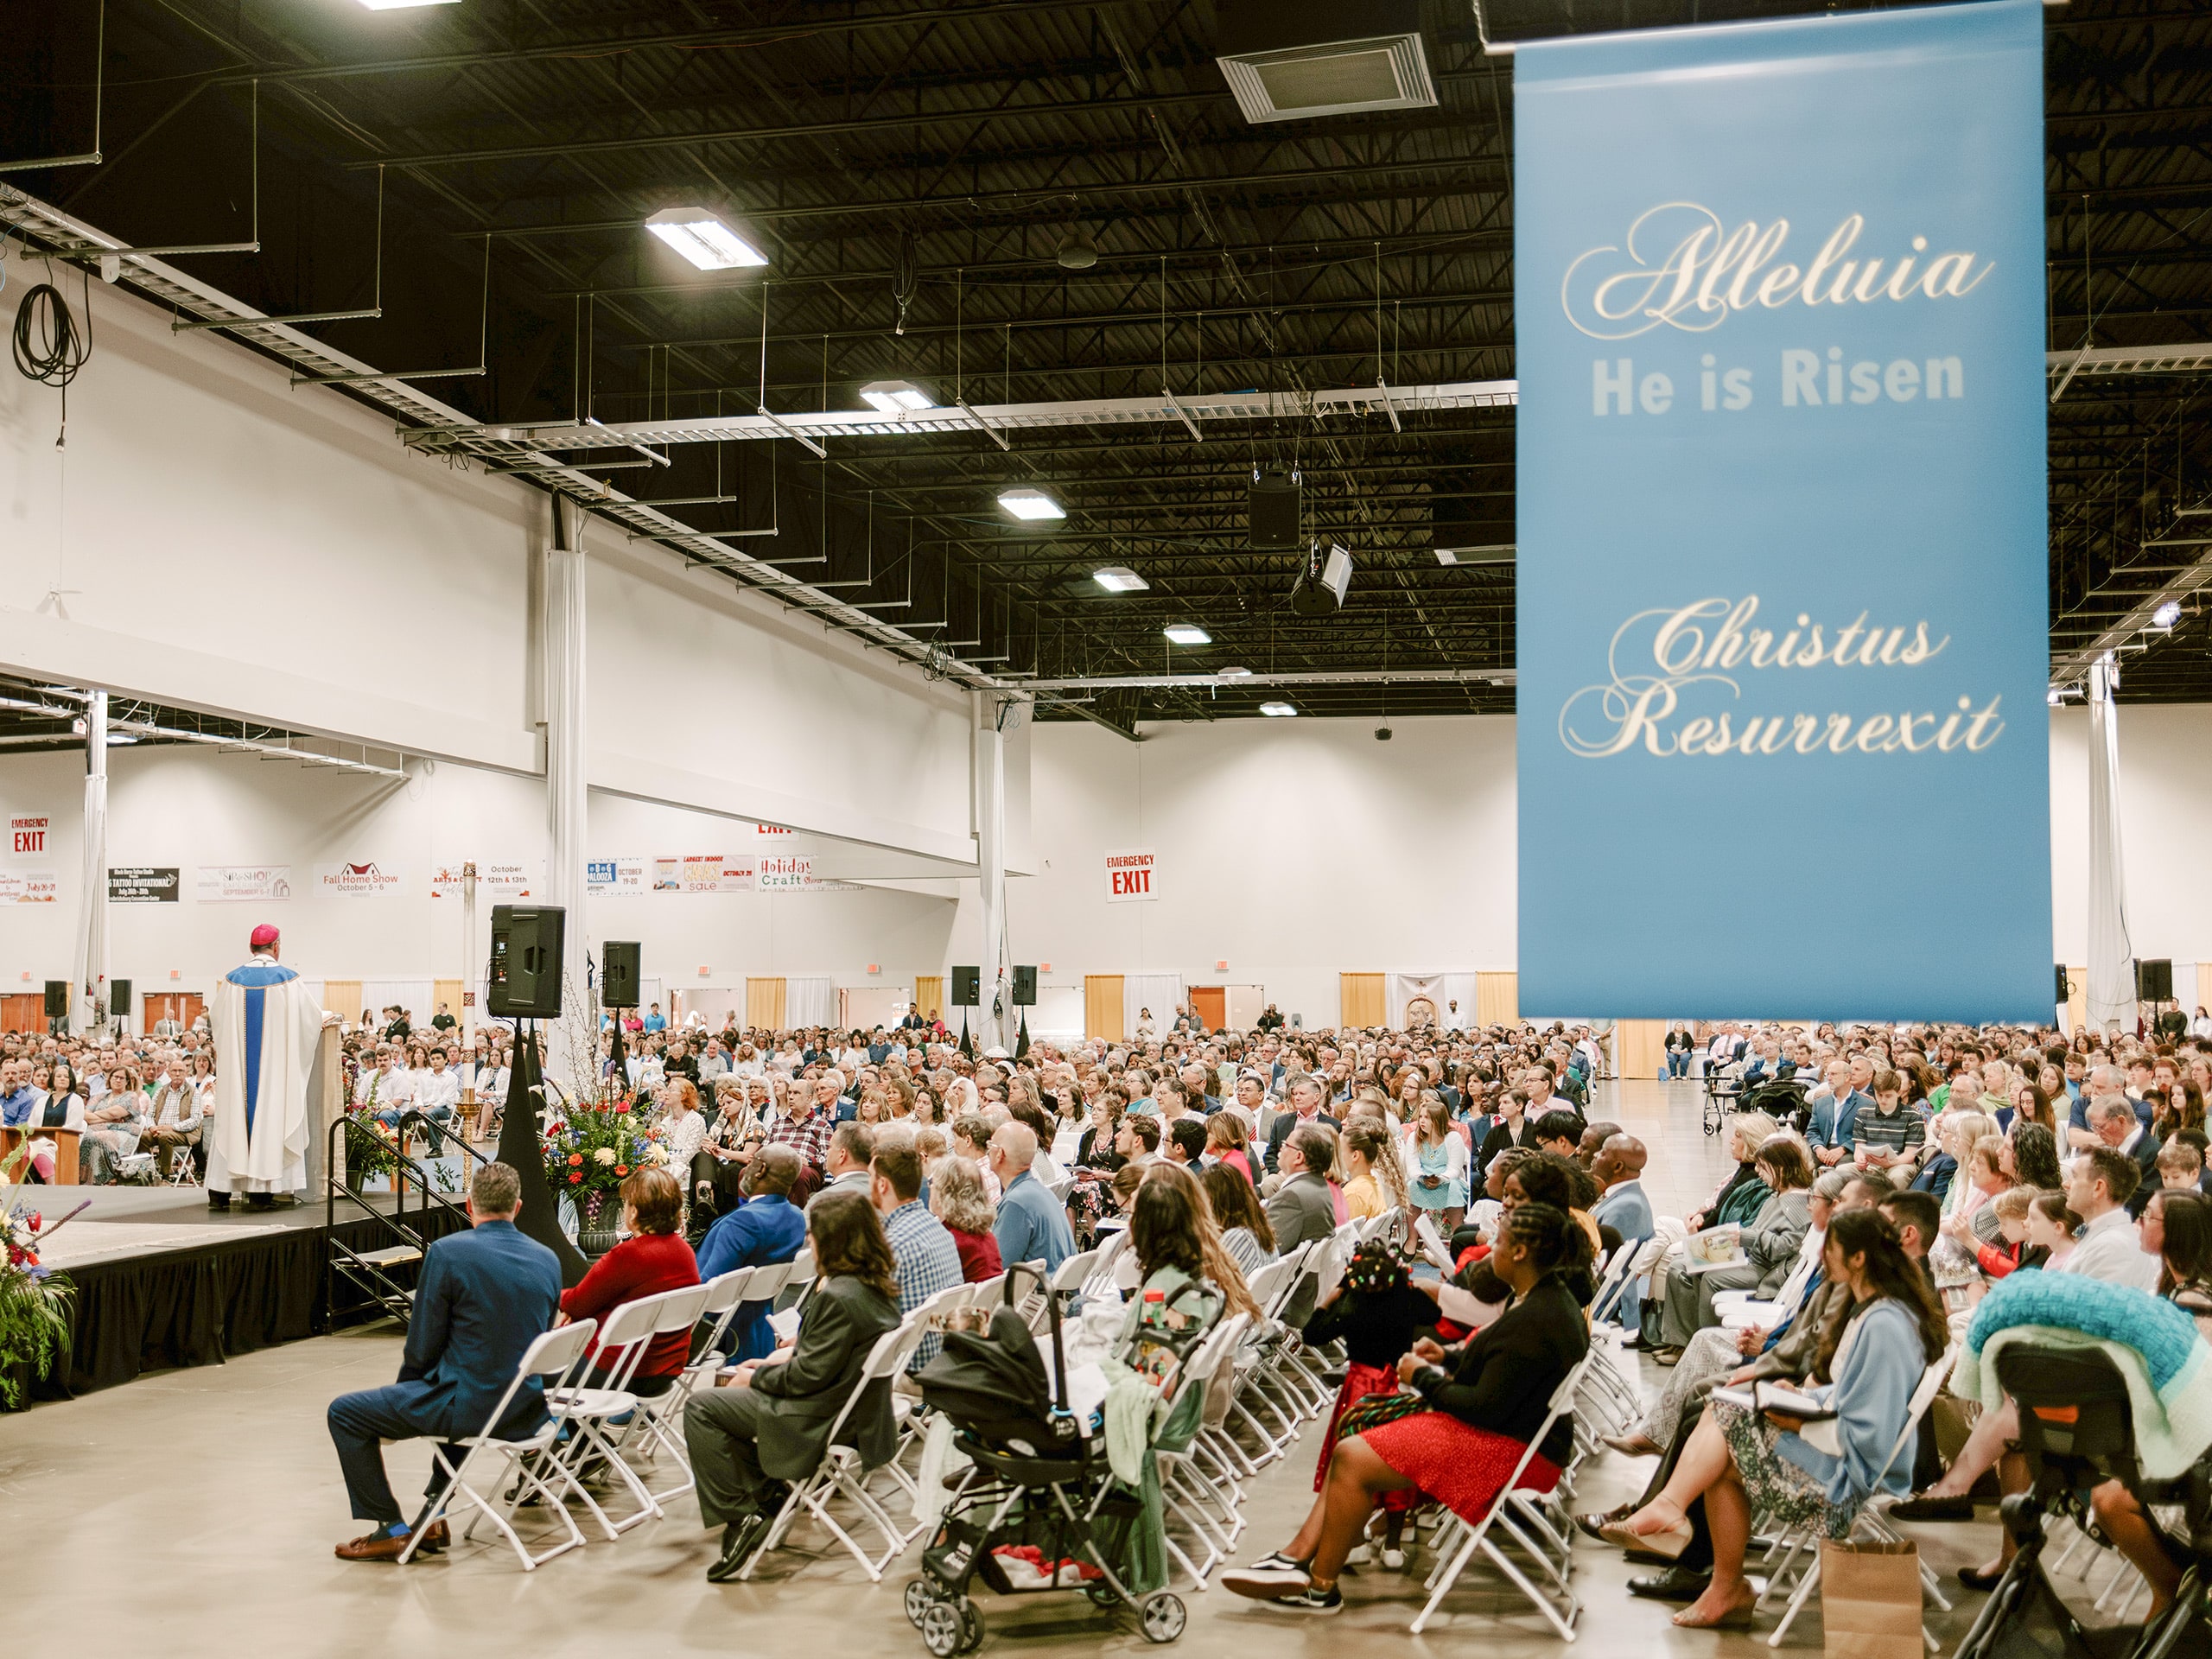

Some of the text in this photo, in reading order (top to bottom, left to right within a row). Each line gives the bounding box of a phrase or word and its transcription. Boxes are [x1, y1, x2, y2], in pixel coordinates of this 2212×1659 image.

[1561, 201, 1995, 340] Alleluia
[1592, 346, 1964, 416] He is Risen
[1608, 594, 1950, 694] Christus
[1558, 674, 2006, 758] Resurrexit
[11, 817, 48, 829] EMERGENCY
[15, 831, 45, 852] EXIT
[1106, 854, 1154, 868] EMERGENCY
[27, 883, 41, 892] July
[112, 879, 132, 887] TATTOO
[132, 878, 169, 887] INVITATIONAL
[323, 874, 398, 884] Fall Home Show
[761, 874, 801, 885] Craft
[1112, 869, 1151, 894] EXIT
